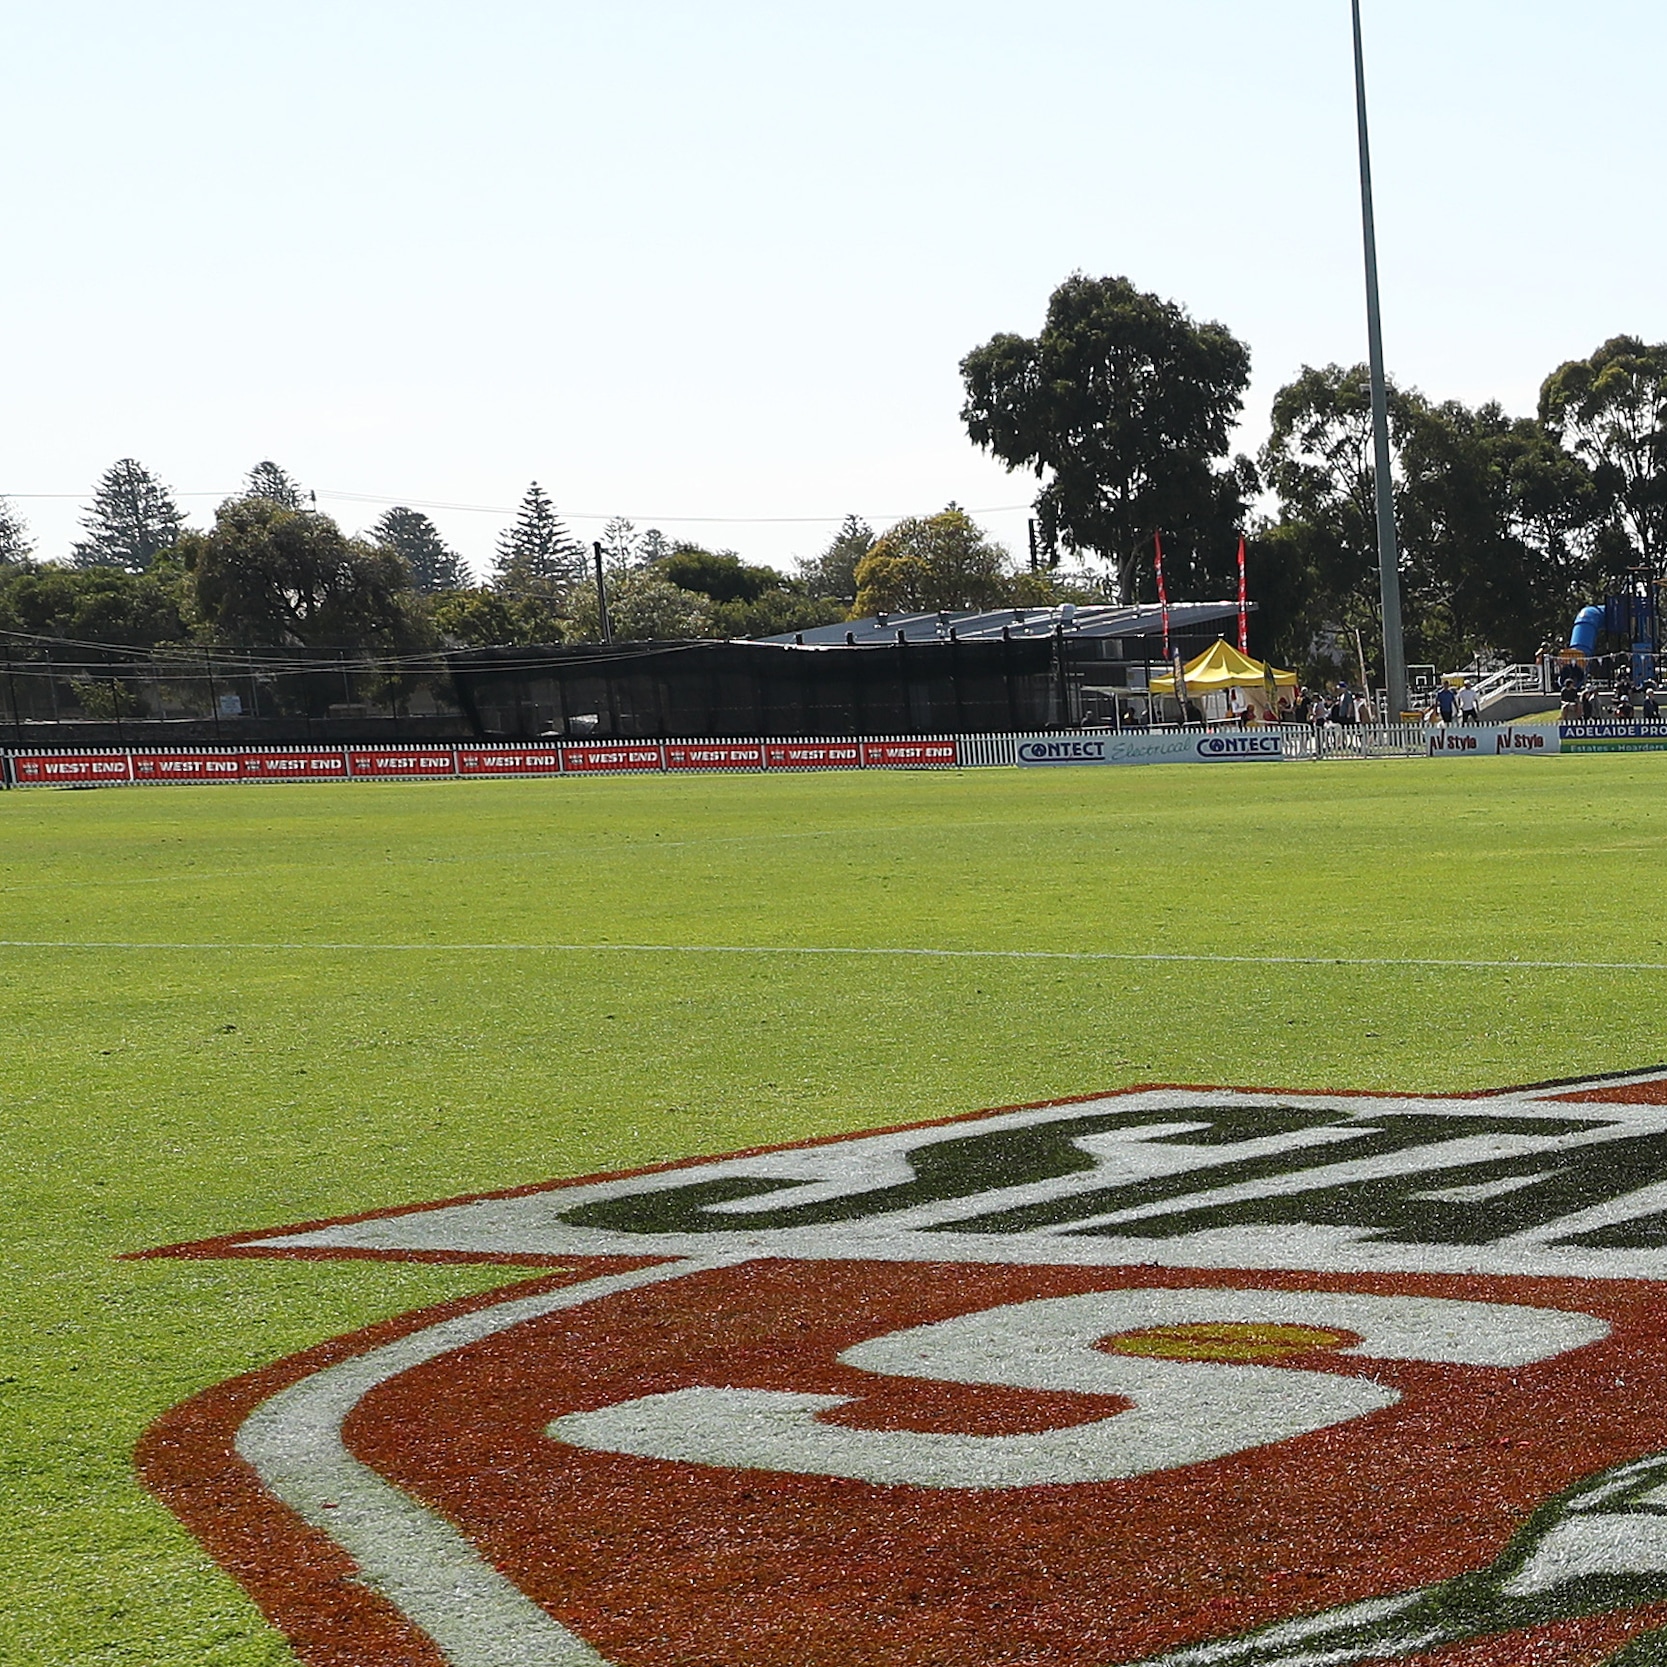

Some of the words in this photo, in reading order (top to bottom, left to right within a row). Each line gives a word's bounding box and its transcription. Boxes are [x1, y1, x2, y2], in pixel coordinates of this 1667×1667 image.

[1565, 726, 1636, 737] ADELAIDE
[1196, 736, 1280, 756] CONTECT
[1447, 735, 1477, 750] Style
[1514, 734, 1544, 749] Style
[886, 748, 923, 758] WEST
[925, 747, 953, 757] END
[1018, 742, 1106, 762] CONTECT
[1112, 737, 1192, 760] Electrical
[588, 754, 628, 763] WEST
[629, 752, 658, 762] END
[690, 752, 728, 761] WEST
[730, 750, 759, 760] END
[789, 750, 827, 760] WEST
[828, 749, 857, 759] END
[159, 762, 204, 772] WEST
[206, 762, 238, 772] END
[266, 760, 308, 770] WEST
[310, 759, 342, 769] END
[376, 758, 418, 768] WEST
[420, 758, 450, 768] END
[483, 757, 523, 767] WEST
[526, 756, 555, 766] END
[45, 765, 90, 774] WEST
[92, 762, 126, 773] END
